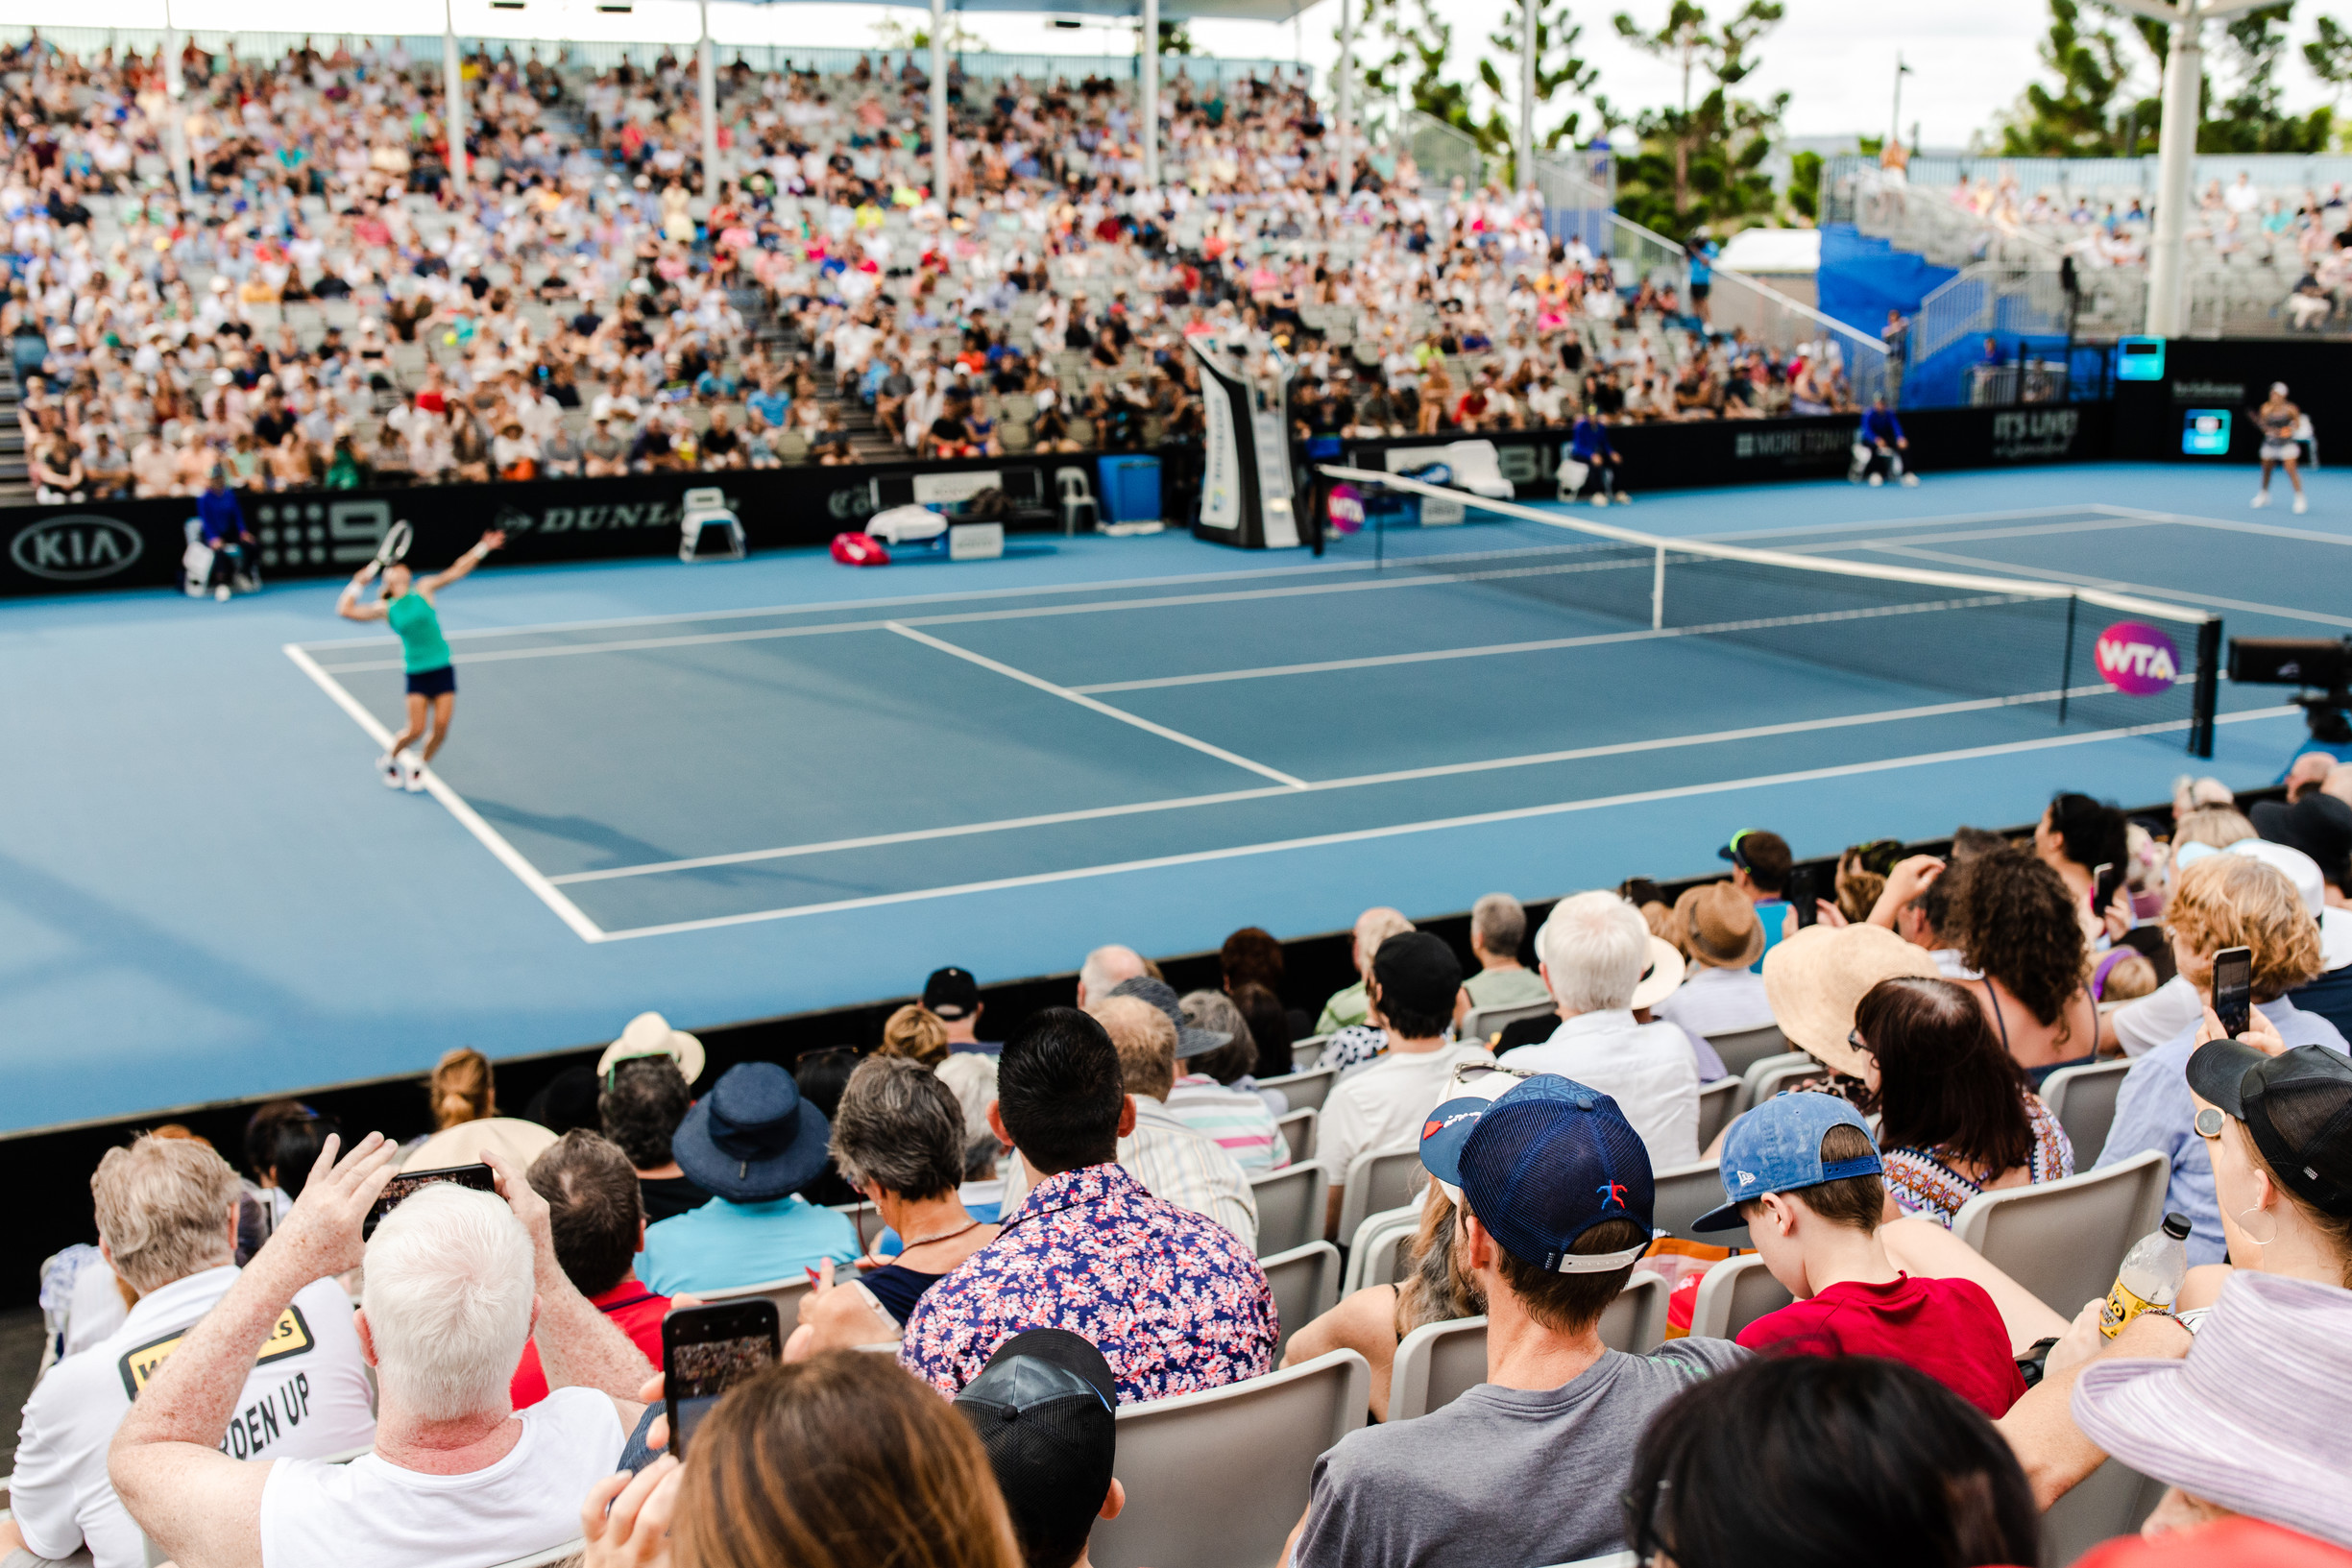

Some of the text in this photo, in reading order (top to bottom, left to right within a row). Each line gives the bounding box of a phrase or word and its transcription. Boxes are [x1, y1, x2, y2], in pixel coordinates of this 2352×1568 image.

[1328, 495, 1365, 522] WTA
[35, 527, 121, 567] KIA
[2097, 637, 2176, 682] WTA
[2107, 1291, 2122, 1317] OLO
[280, 1371, 308, 1426] UP
